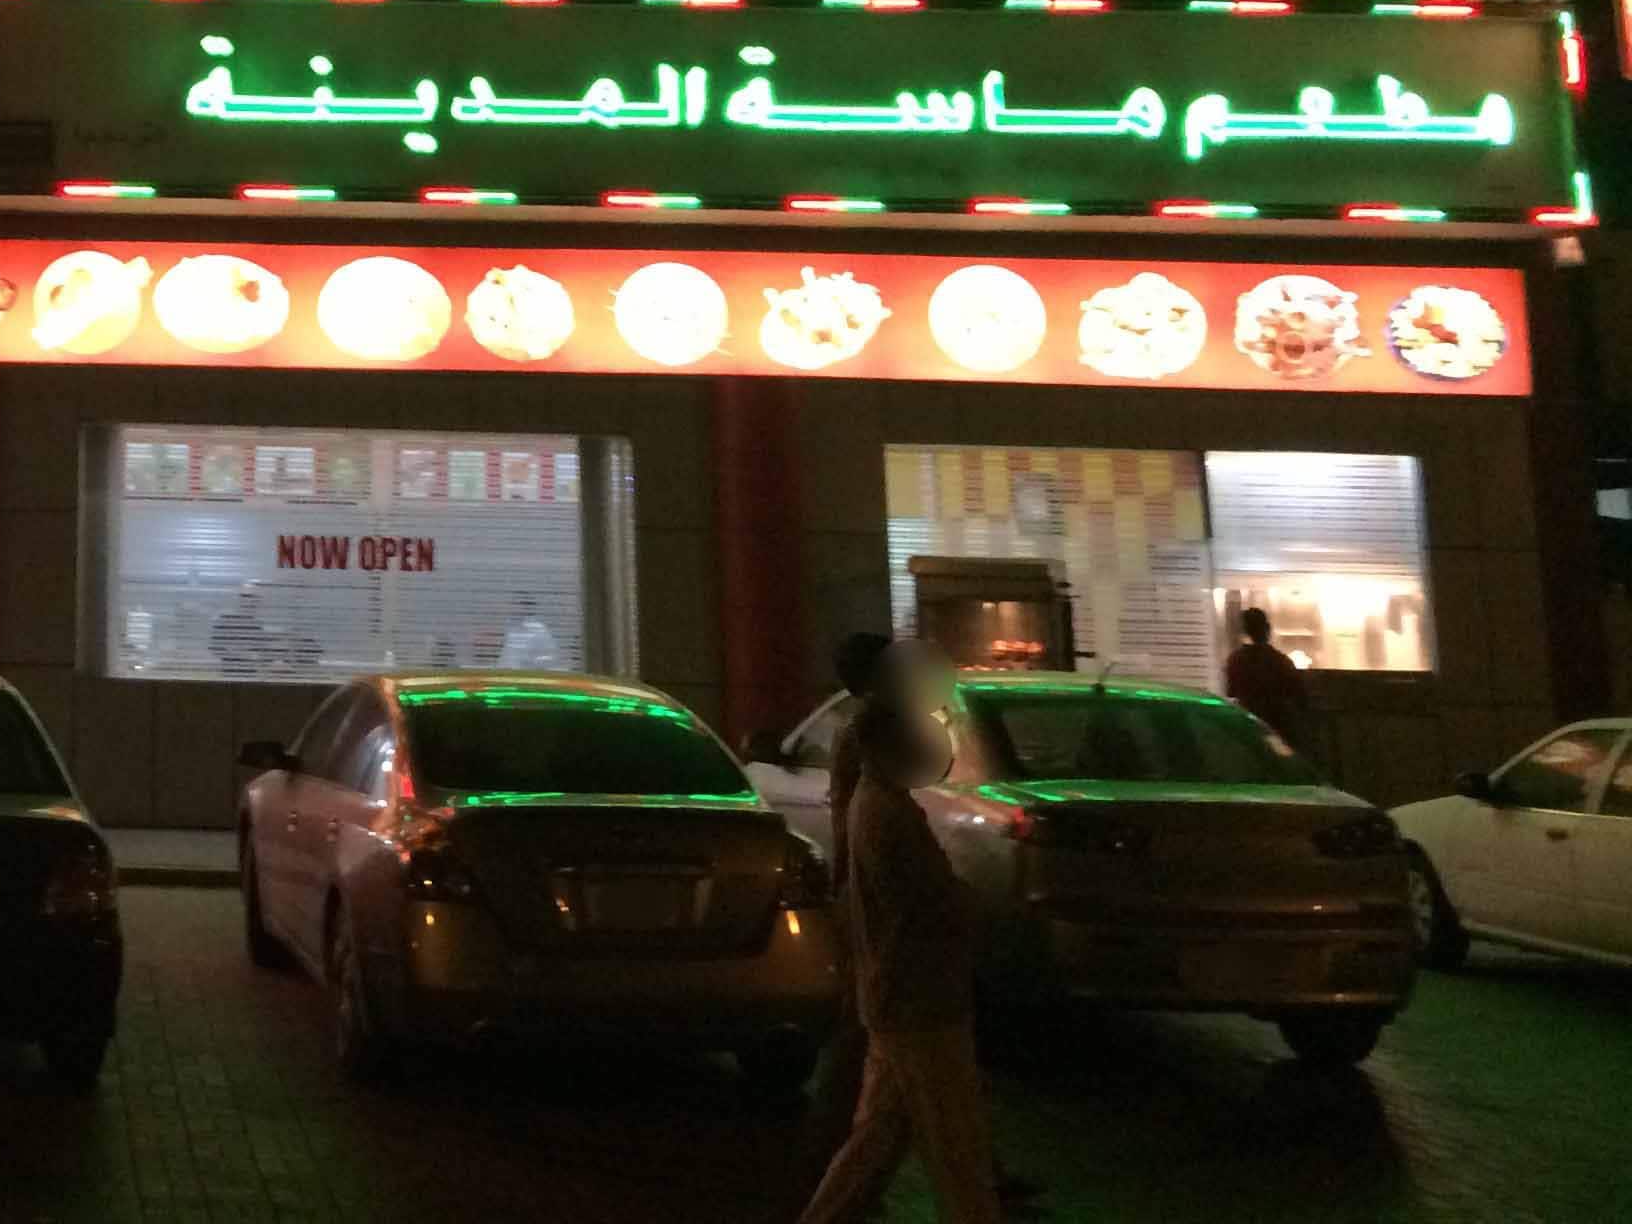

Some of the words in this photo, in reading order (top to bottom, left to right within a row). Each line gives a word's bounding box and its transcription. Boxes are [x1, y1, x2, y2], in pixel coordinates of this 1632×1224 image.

[185, 35, 708, 154] المدينة
[724, 45, 1168, 139] ماسة
[1184, 74, 1515, 161] مطعم
[277, 534, 350, 570] NOW
[359, 535, 435, 572] OPEN
